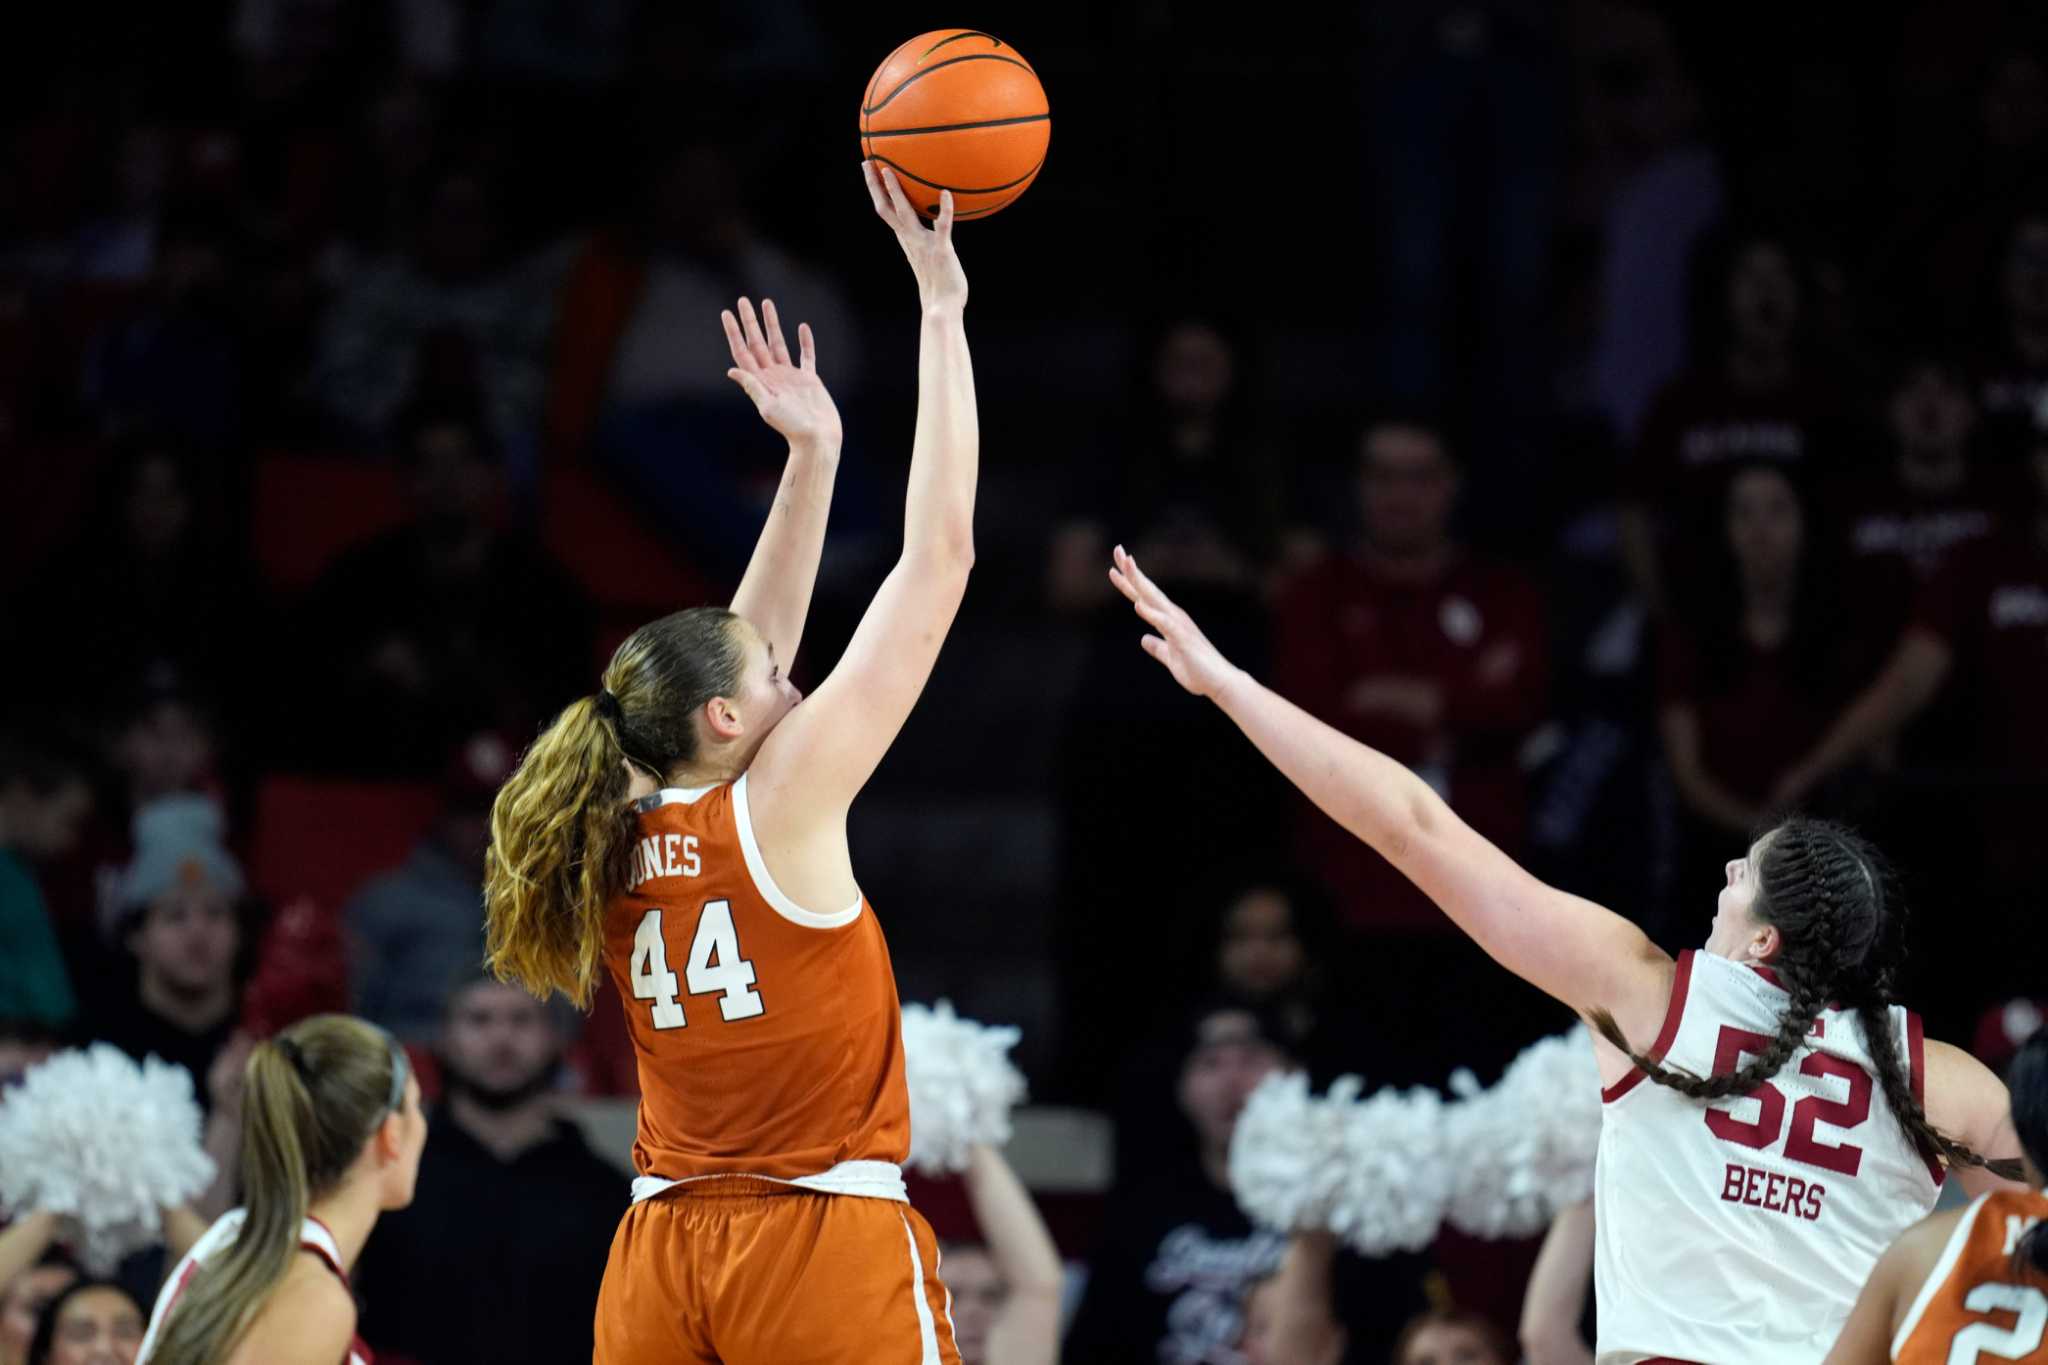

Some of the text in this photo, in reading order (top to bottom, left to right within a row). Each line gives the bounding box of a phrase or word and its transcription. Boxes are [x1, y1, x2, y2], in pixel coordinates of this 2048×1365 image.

[630, 899, 765, 1030] 44
[1704, 1025, 1873, 1177] 52
[1721, 1163, 1825, 1221] BEERS
